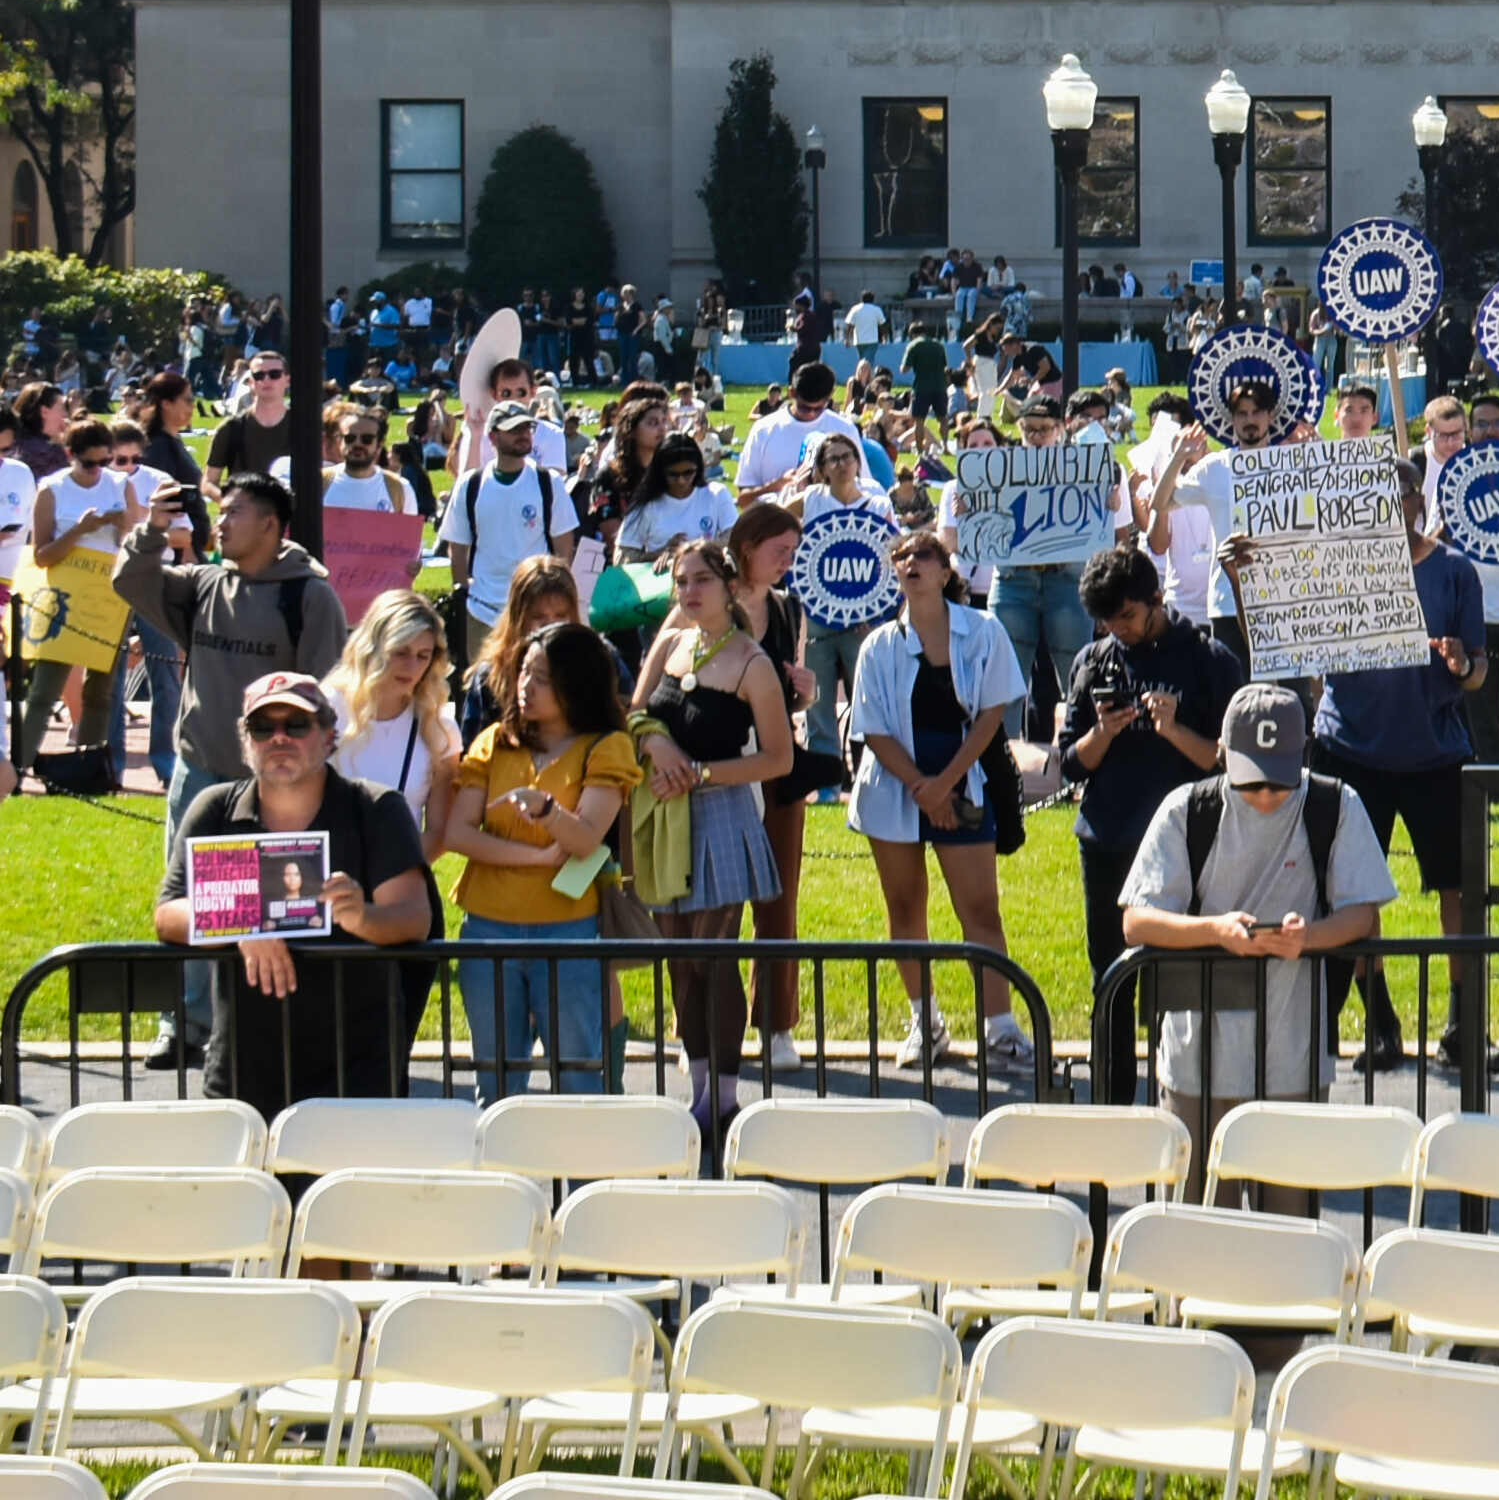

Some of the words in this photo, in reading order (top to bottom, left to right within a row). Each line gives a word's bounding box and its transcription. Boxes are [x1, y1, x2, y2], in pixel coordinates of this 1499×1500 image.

[1355, 267, 1403, 297] UAW
[957, 443, 1113, 491] COLUMBIA
[1247, 496, 1315, 538] PAUL
[1316, 489, 1402, 534] ROBESON
[823, 556, 876, 583] UAW
[1250, 627, 1289, 650] PAUL
[1292, 619, 1354, 642] ROBESON
[1257, 720, 1278, 748] C
[203, 879, 259, 896] PREDATOR
